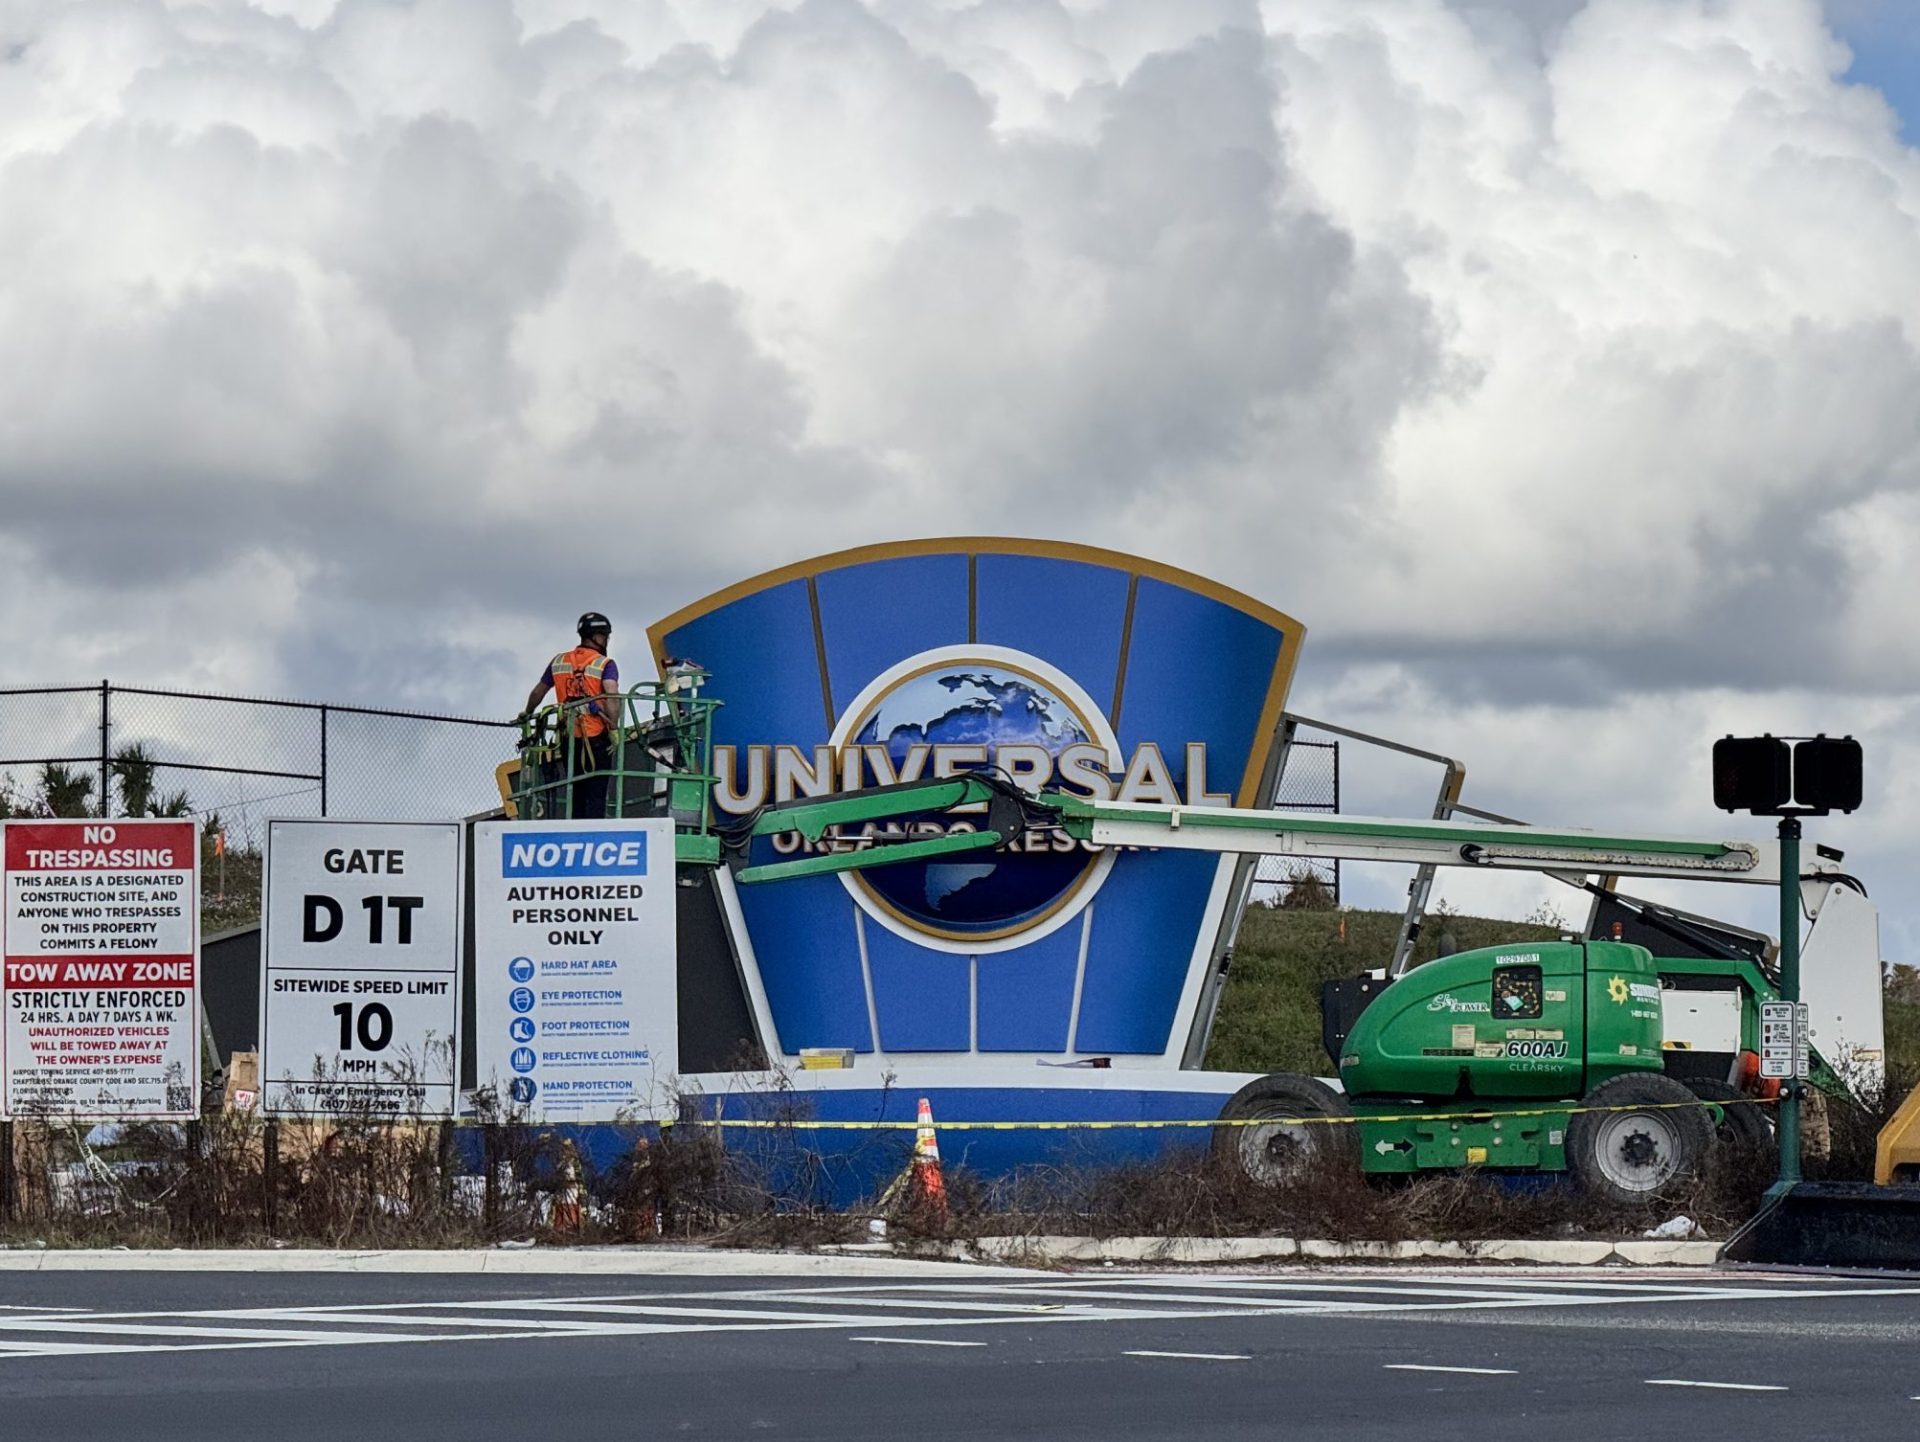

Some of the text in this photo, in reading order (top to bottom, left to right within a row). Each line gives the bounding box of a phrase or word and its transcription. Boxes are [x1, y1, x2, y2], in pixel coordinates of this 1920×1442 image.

[713, 743, 1232, 814] UNIVERSAL
[84, 826, 116, 844] NO
[26, 849, 174, 868] TRESPASSING
[510, 842, 641, 868] NOTICE
[324, 849, 404, 874] GATE
[14, 875, 184, 887] THIS AREA IS A DESIGNATED
[20, 891, 178, 904] CONSTRUCTION SITE, AND
[507, 885, 644, 902] AUTHORIZED
[18, 907, 182, 918] ANYONE WHO TRESPASSES
[512, 908, 639, 924] PERSONNEL
[303, 894, 424, 944] D 1T
[41, 923, 157, 934] ON THIS PROPERTY
[40, 938, 158, 950] COMMITS A FELONY
[548, 930, 604, 946] ONLY
[542, 960, 618, 970] HARD HAT AREA
[6, 962, 192, 982] TOW AWAY ZONE
[274, 979, 449, 996] SITEWIDE SPEED LIMIT
[12, 990, 186, 1009] STRICTLY ENFORCED
[542, 990, 622, 1000] EYE PROTECTION
[20, 1011, 177, 1023] 24 HRS. A DAY 7 DAYS A WK.
[28, 1026, 170, 1036] UNAUTHORIZED VEHICLES
[333, 1002, 394, 1052] 10
[542, 1020, 630, 1030] FOOT PROTECTION
[30, 1041, 168, 1050] WILL BE TOWED AWAY AT
[1507, 1041, 1568, 1058] 600AJ
[36, 1055, 162, 1065] THE OWNER'S EXPENSE
[542, 1050, 649, 1060] REFLECTIVE CLOTHING
[66, 1068, 90, 1076] SERVICE
[343, 1060, 376, 1073] MPH
[1509, 1063, 1564, 1073] CLEARSKY
[542, 1080, 633, 1090] HAND PROTECTION
[296, 1086, 426, 1098] In Case of Emergency Call
